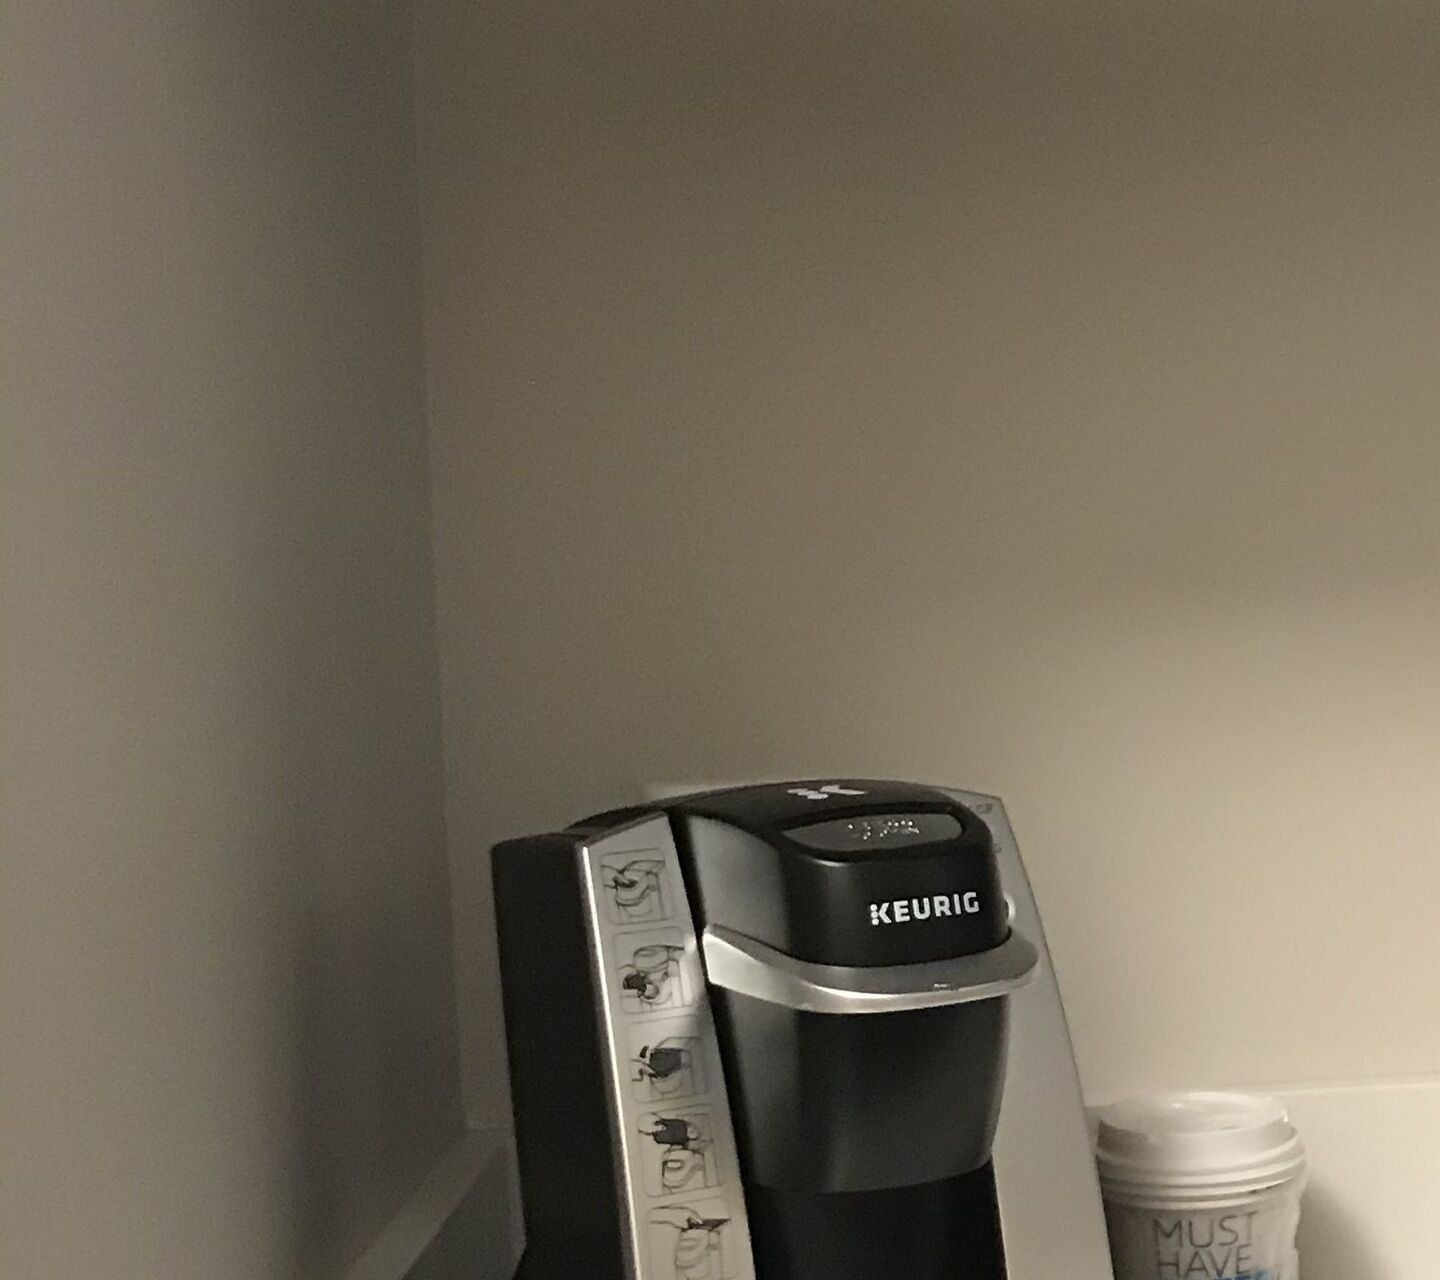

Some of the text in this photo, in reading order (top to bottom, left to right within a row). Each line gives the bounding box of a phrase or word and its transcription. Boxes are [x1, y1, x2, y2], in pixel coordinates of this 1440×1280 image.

[870, 891, 980, 926] KEURIG
[1153, 1210, 1259, 1249] MUST
[1156, 1243, 1251, 1279] HAVE
